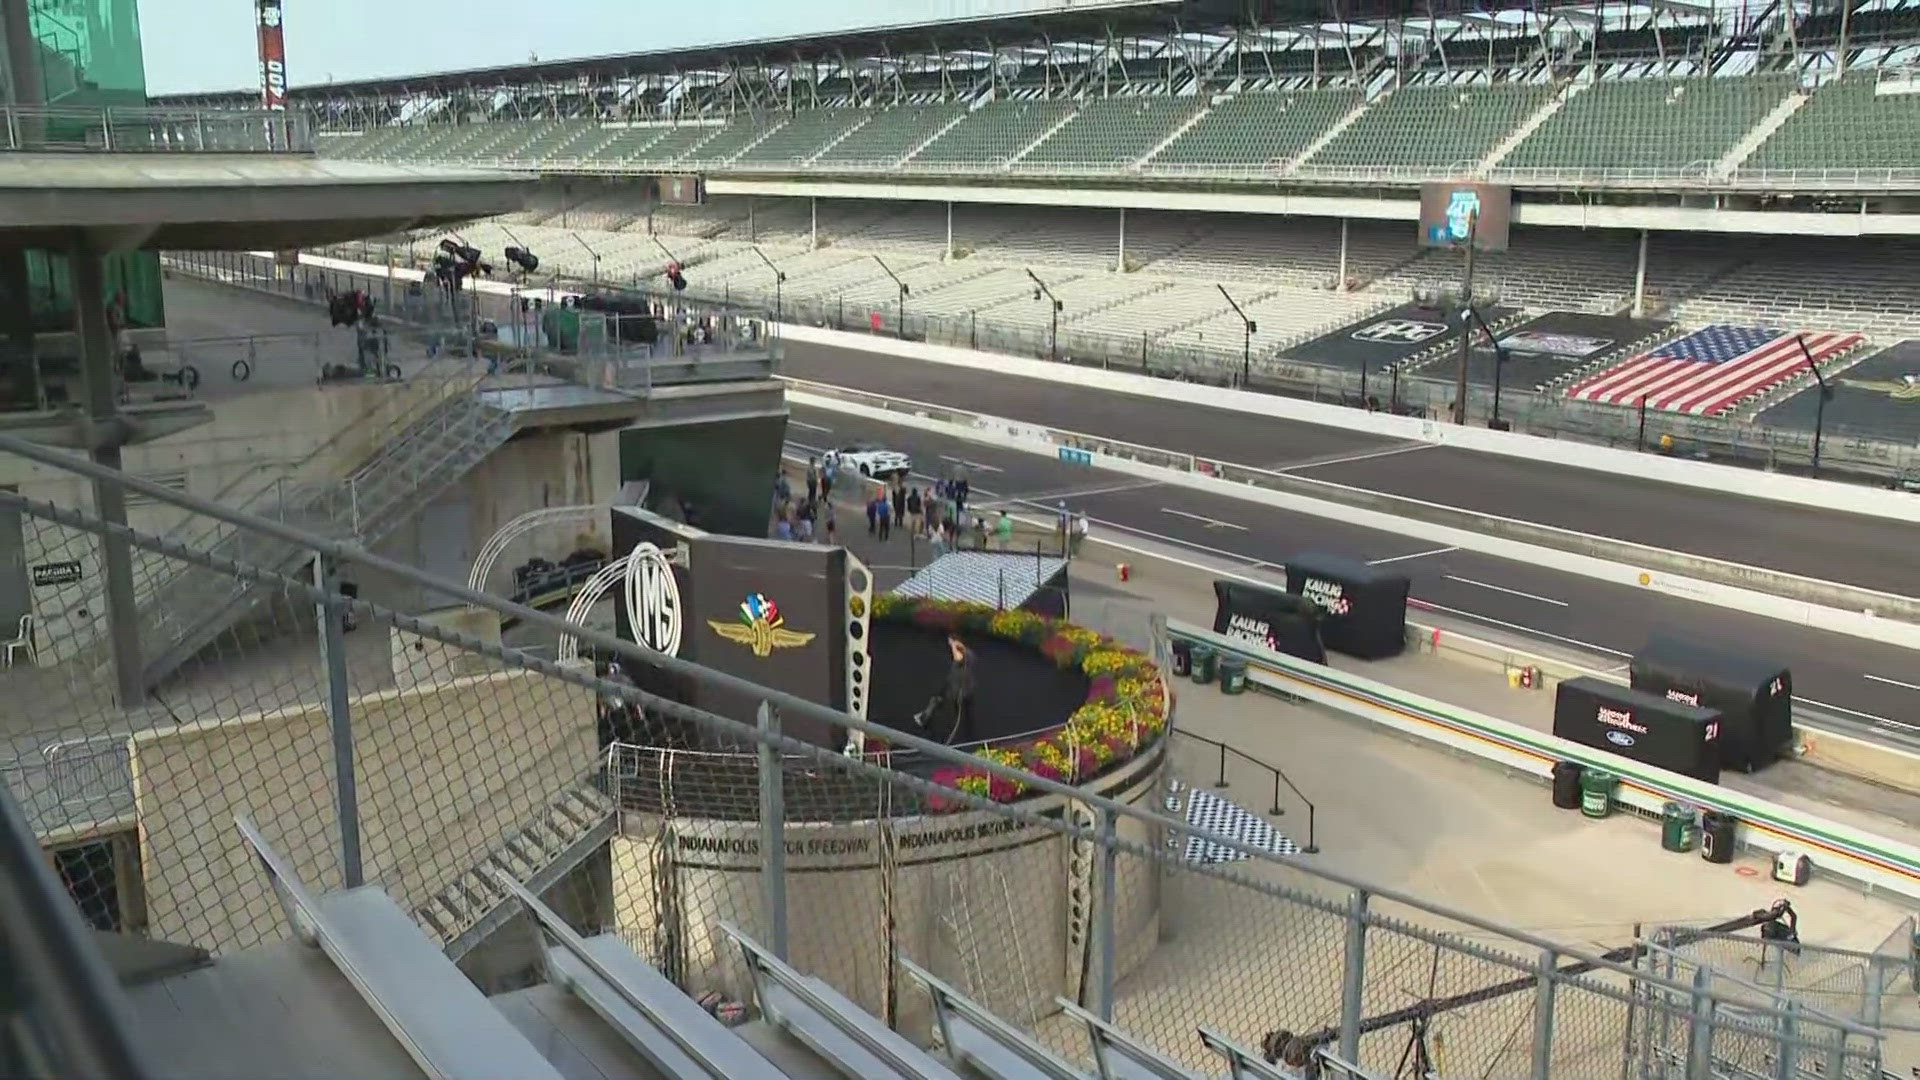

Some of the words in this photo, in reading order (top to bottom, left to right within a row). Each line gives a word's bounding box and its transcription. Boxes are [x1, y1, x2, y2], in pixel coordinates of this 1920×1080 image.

[268, 60, 285, 99] 400
[1304, 578, 1343, 597] KAULIG
[633, 553, 676, 651] IMS
[1230, 613, 1270, 634] KAULIG
[1704, 722, 1719, 742] 21
[679, 835, 759, 855] INDIANAPOLIS
[807, 838, 870, 854] SPEEDWAY
